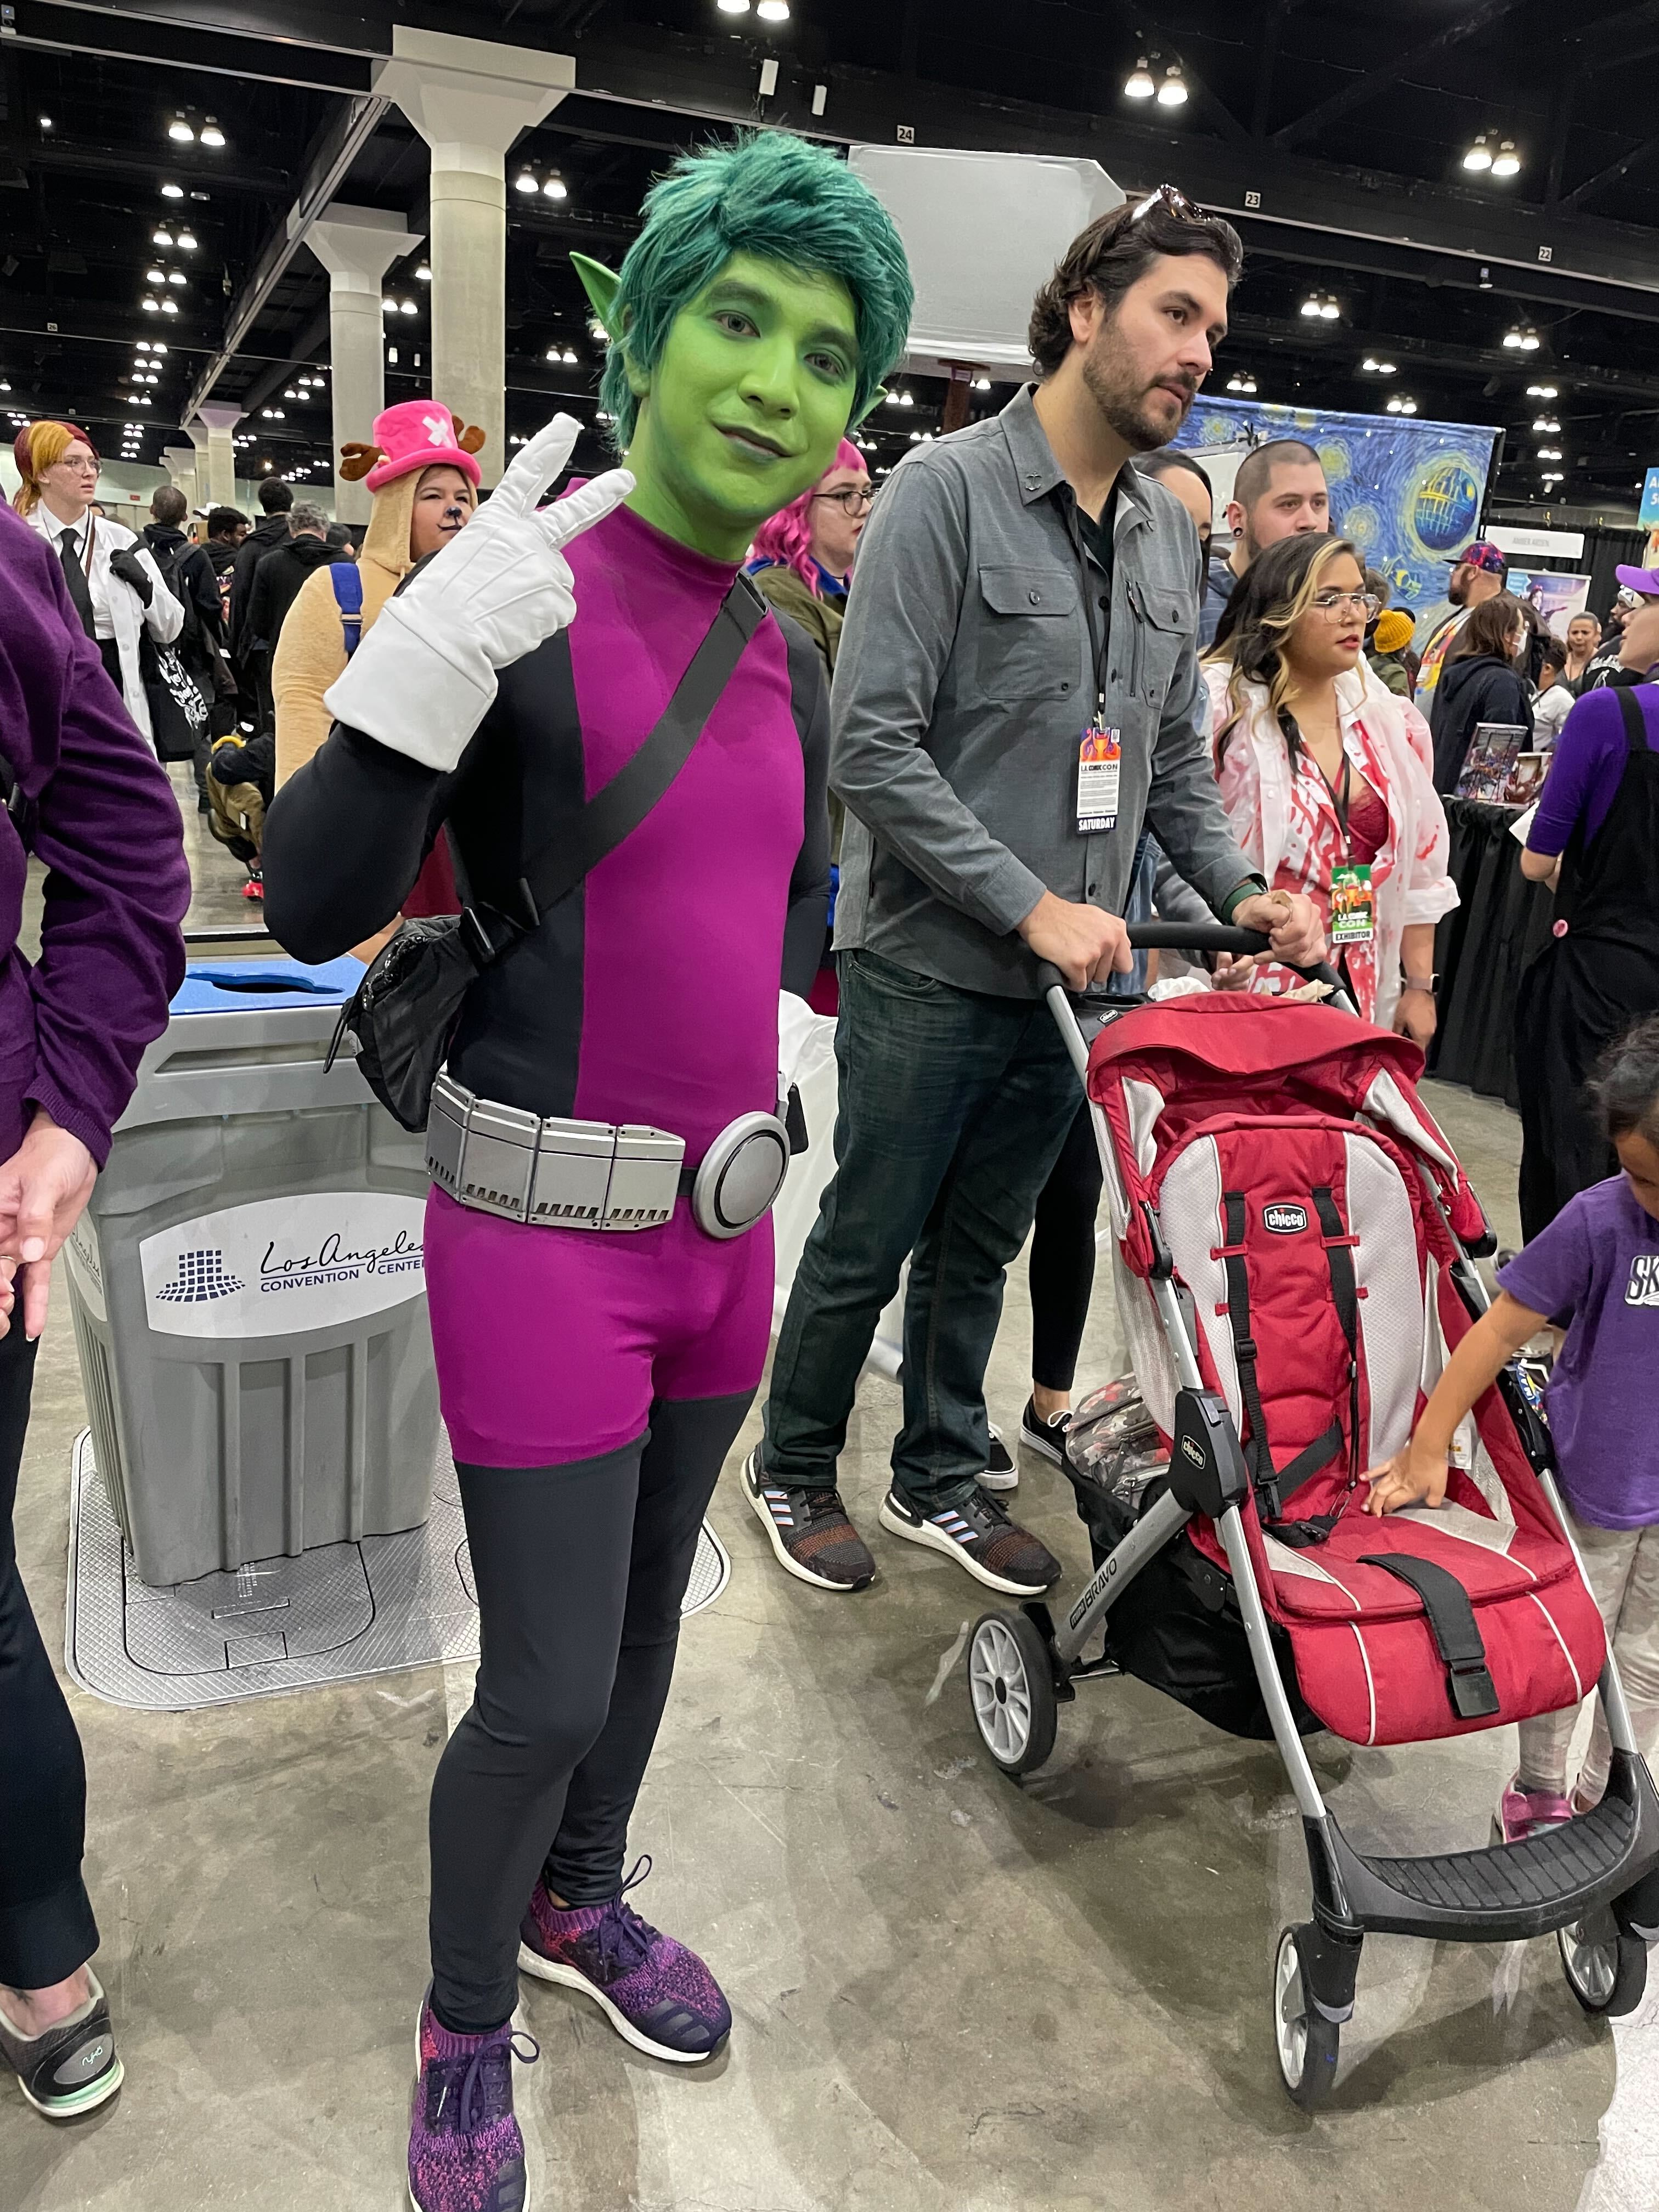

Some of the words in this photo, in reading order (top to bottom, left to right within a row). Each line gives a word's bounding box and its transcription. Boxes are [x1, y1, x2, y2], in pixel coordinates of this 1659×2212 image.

[899, 128, 912, 140] 24
[1247, 194, 1259, 205] 23
[1540, 249, 1550, 259] 22
[1079, 817, 1115, 831] SATURDAY
[1339, 919, 1366, 928] CON
[1335, 930, 1370, 941] EXHIBITOR
[1268, 1208, 1303, 1227] chicco
[261, 1242, 318, 1274] Los
[319, 1230, 424, 1273] Angele
[261, 1269, 359, 1292] CONVENTION
[1183, 1441, 1203, 1465] chicco
[1085, 1558, 1117, 1609] BRAVO
